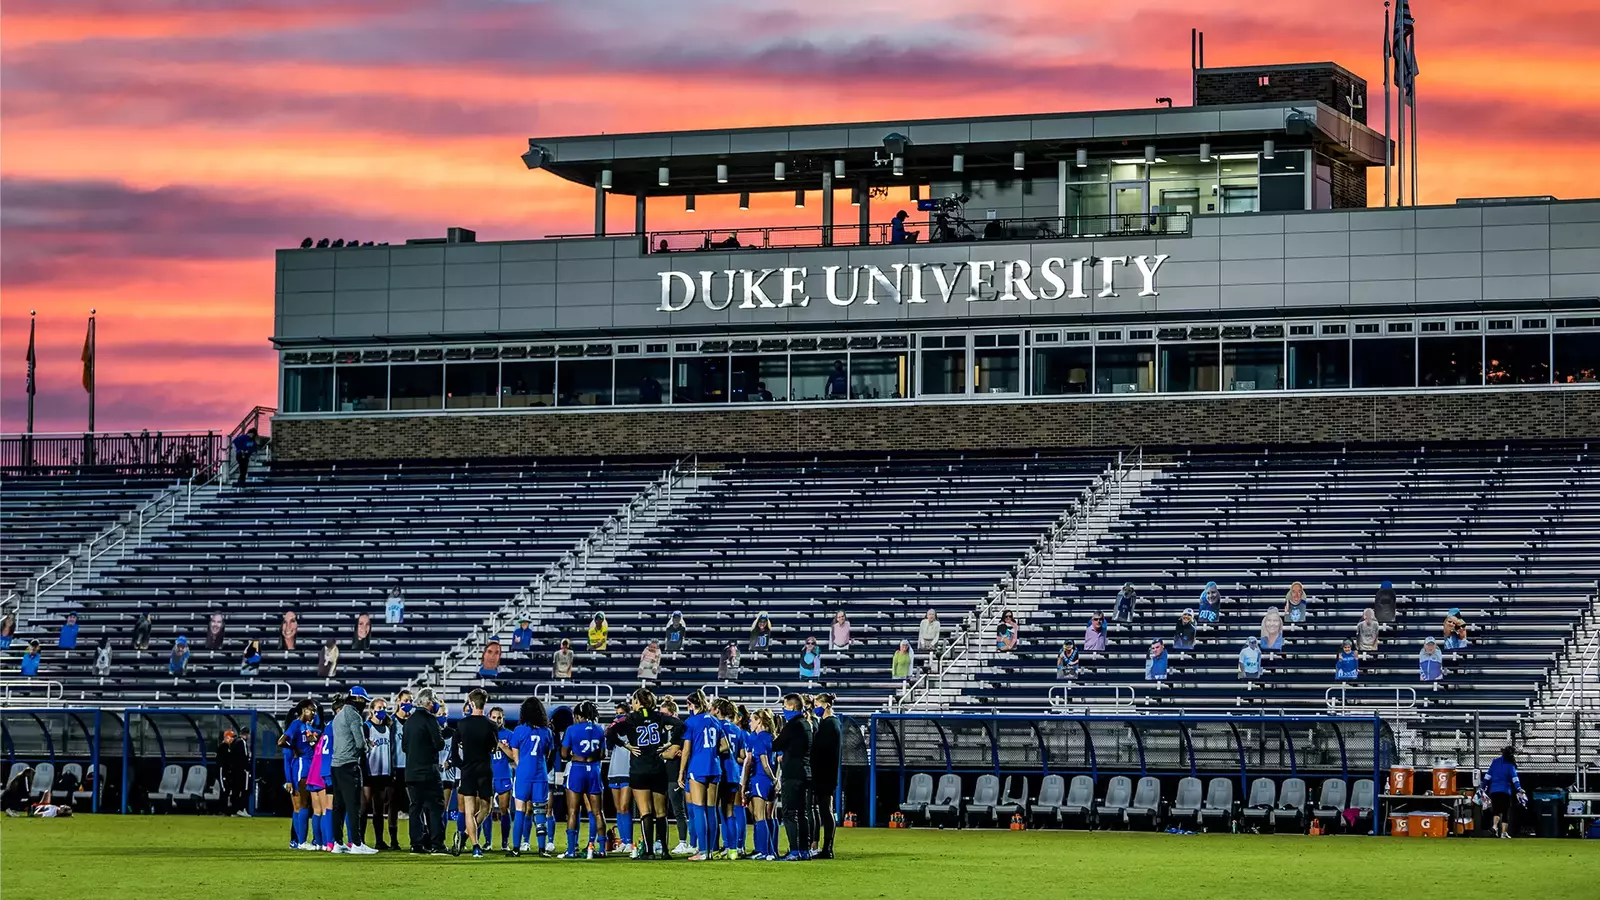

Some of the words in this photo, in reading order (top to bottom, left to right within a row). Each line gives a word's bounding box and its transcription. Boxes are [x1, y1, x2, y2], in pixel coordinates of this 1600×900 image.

[656, 266, 810, 312] DUKE
[822, 254, 1171, 306] UNIVERSITY
[375, 737, 391, 747] DUK
[636, 722, 660, 747] 26
[703, 727, 717, 748] 19
[530, 735, 541, 756] 7
[1395, 772, 1403, 781] G
[1438, 772, 1447, 782] G
[1421, 818, 1431, 828] G
